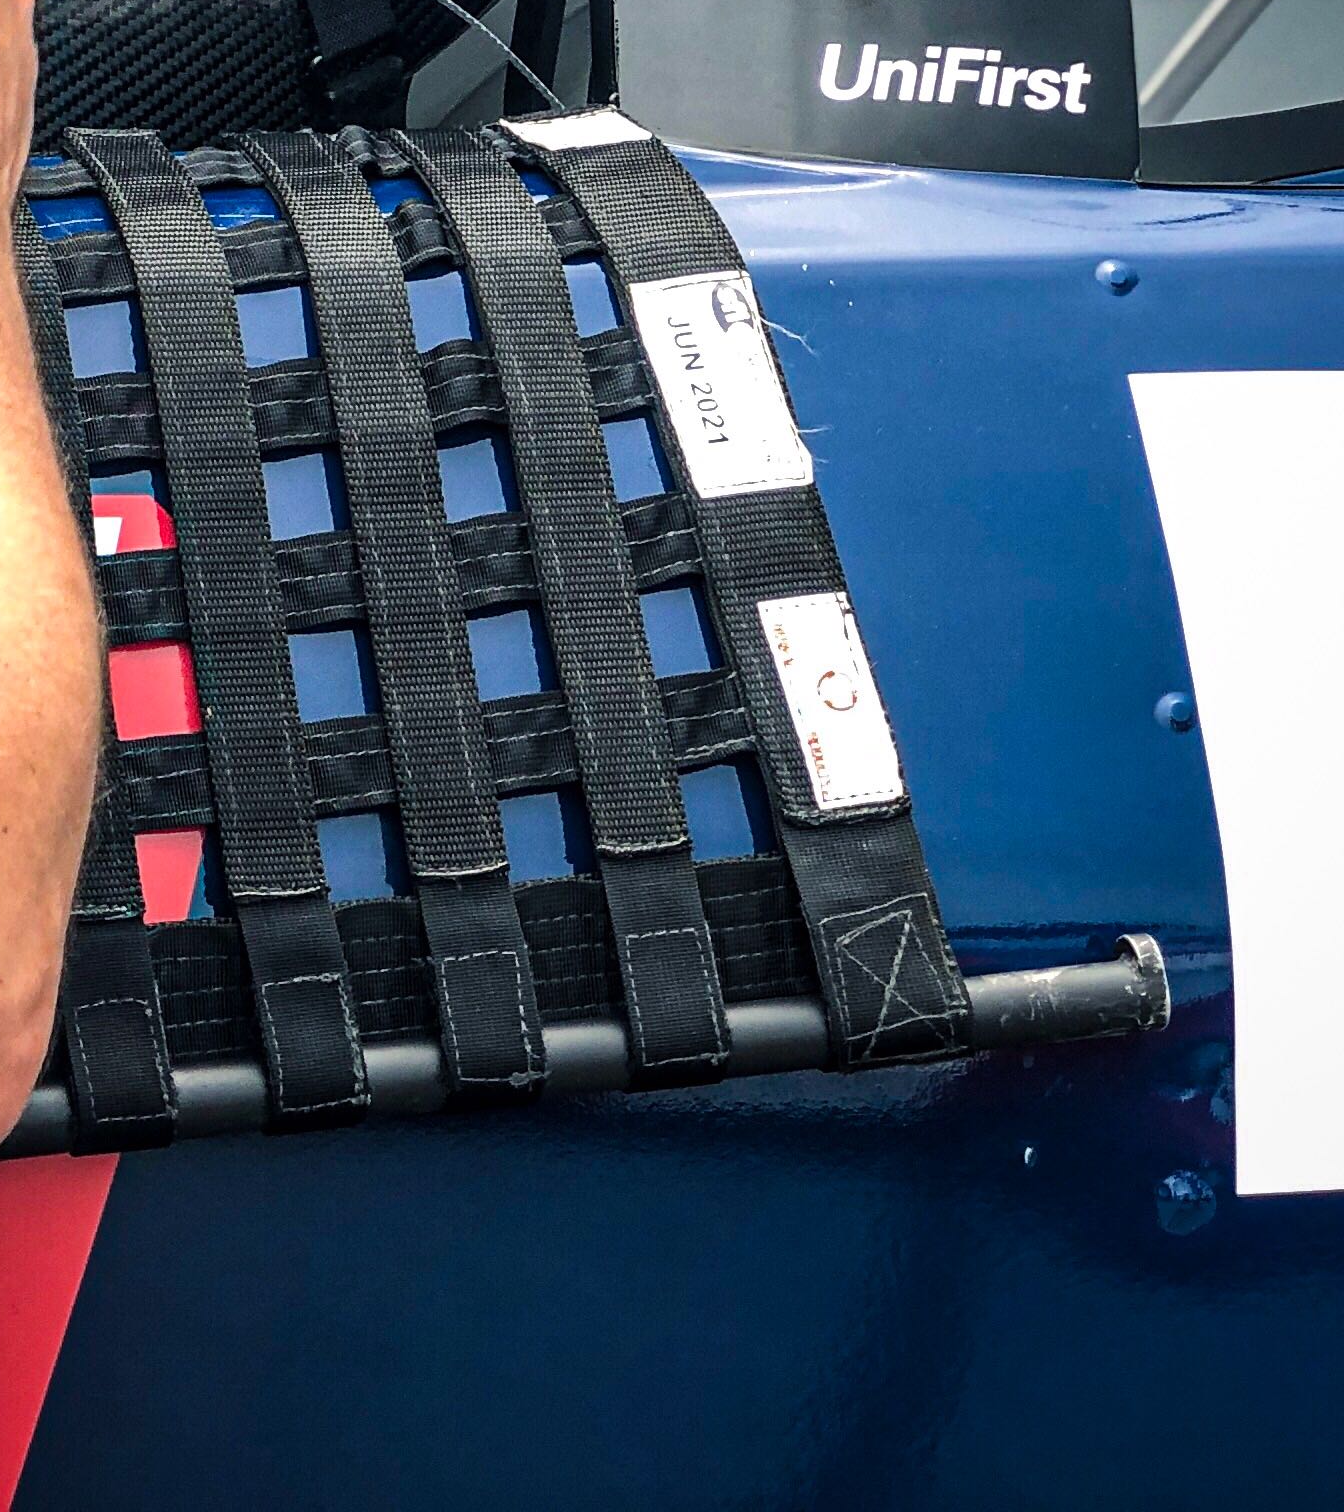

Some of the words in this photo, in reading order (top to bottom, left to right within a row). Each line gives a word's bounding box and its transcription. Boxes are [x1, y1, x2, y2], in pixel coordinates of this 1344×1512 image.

[818, 42, 1092, 114] UniFirst
[668, 316, 705, 370] JUN
[690, 382, 729, 444] 2021
